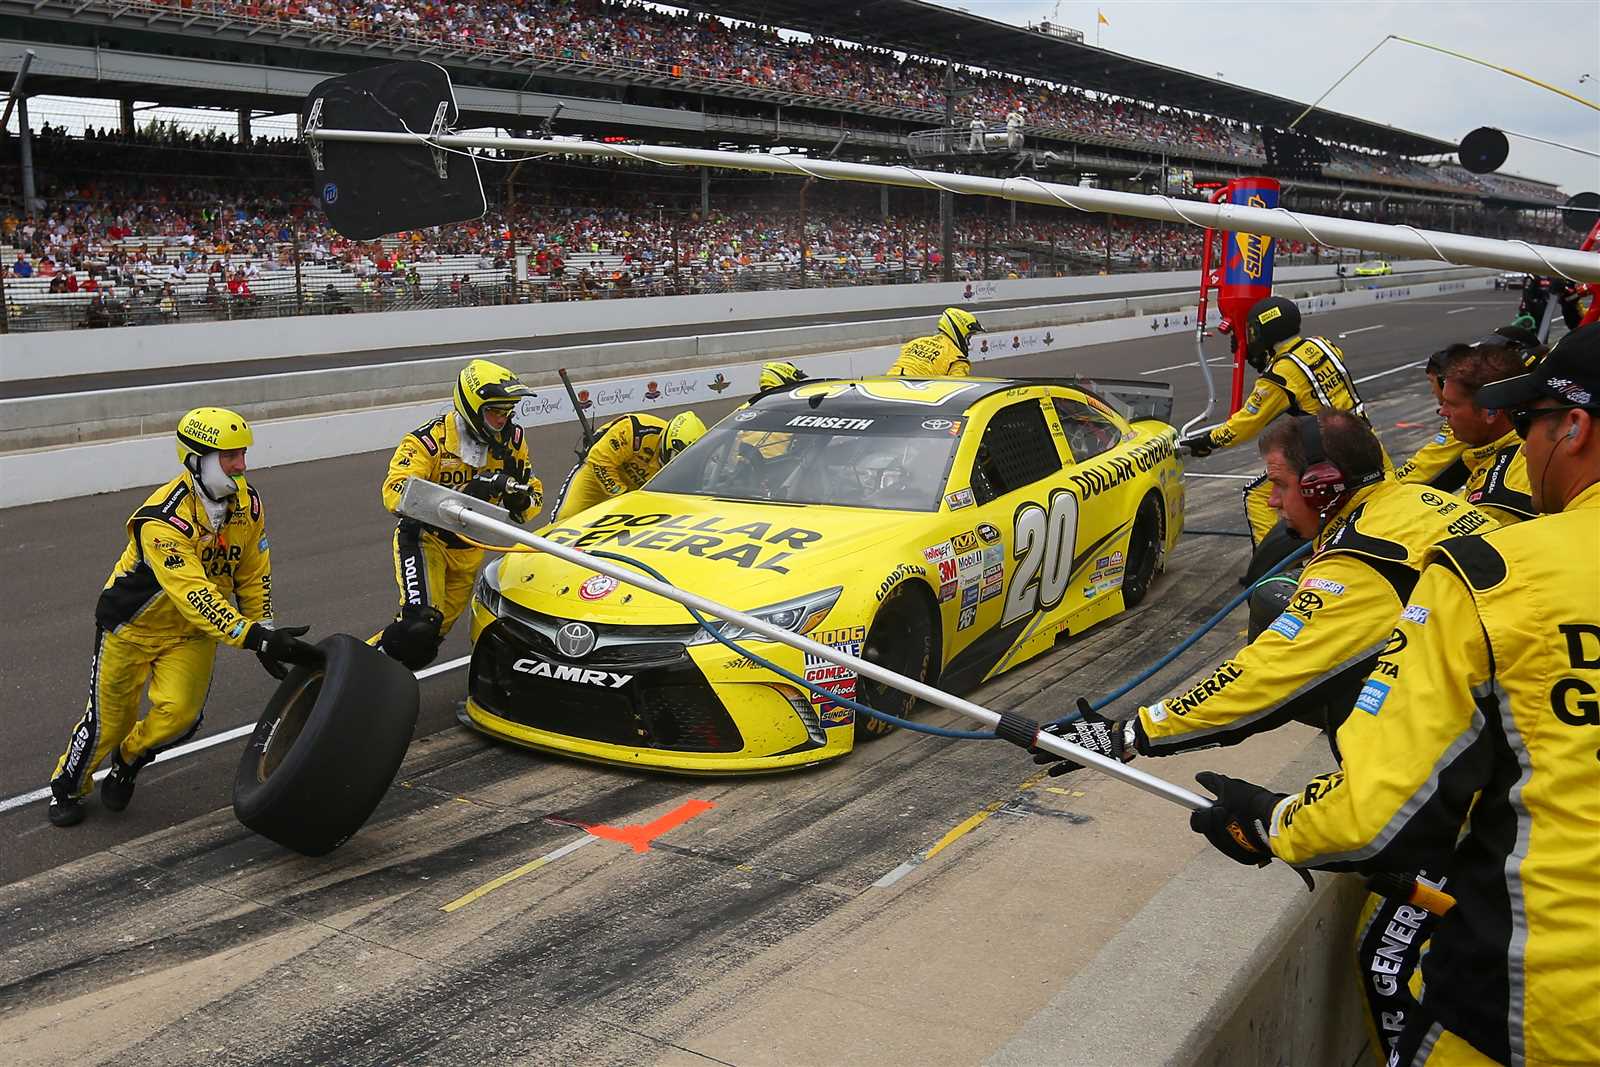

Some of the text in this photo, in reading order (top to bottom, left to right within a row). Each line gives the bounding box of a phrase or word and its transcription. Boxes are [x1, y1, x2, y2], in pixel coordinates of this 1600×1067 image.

[183, 426, 219, 446] GENERAL
[188, 419, 220, 437] DOLLAR
[786, 415, 874, 430] KENSETH
[1070, 433, 1173, 501] DOLLAR GENERAL
[586, 513, 824, 550] DOLLAR
[542, 527, 793, 575] GENERAL
[1001, 488, 1079, 629] 20
[875, 563, 927, 602] GOODYEAR
[939, 558, 957, 583] 3M
[186, 590, 229, 634] GENERAL
[198, 587, 235, 623] DOLLAR
[262, 575, 272, 619] DOLLAR
[806, 627, 864, 645] MOOG
[512, 658, 634, 689] CAMRY
[1170, 665, 1243, 716] ENERAL
[1371, 876, 1448, 997] GENERL
